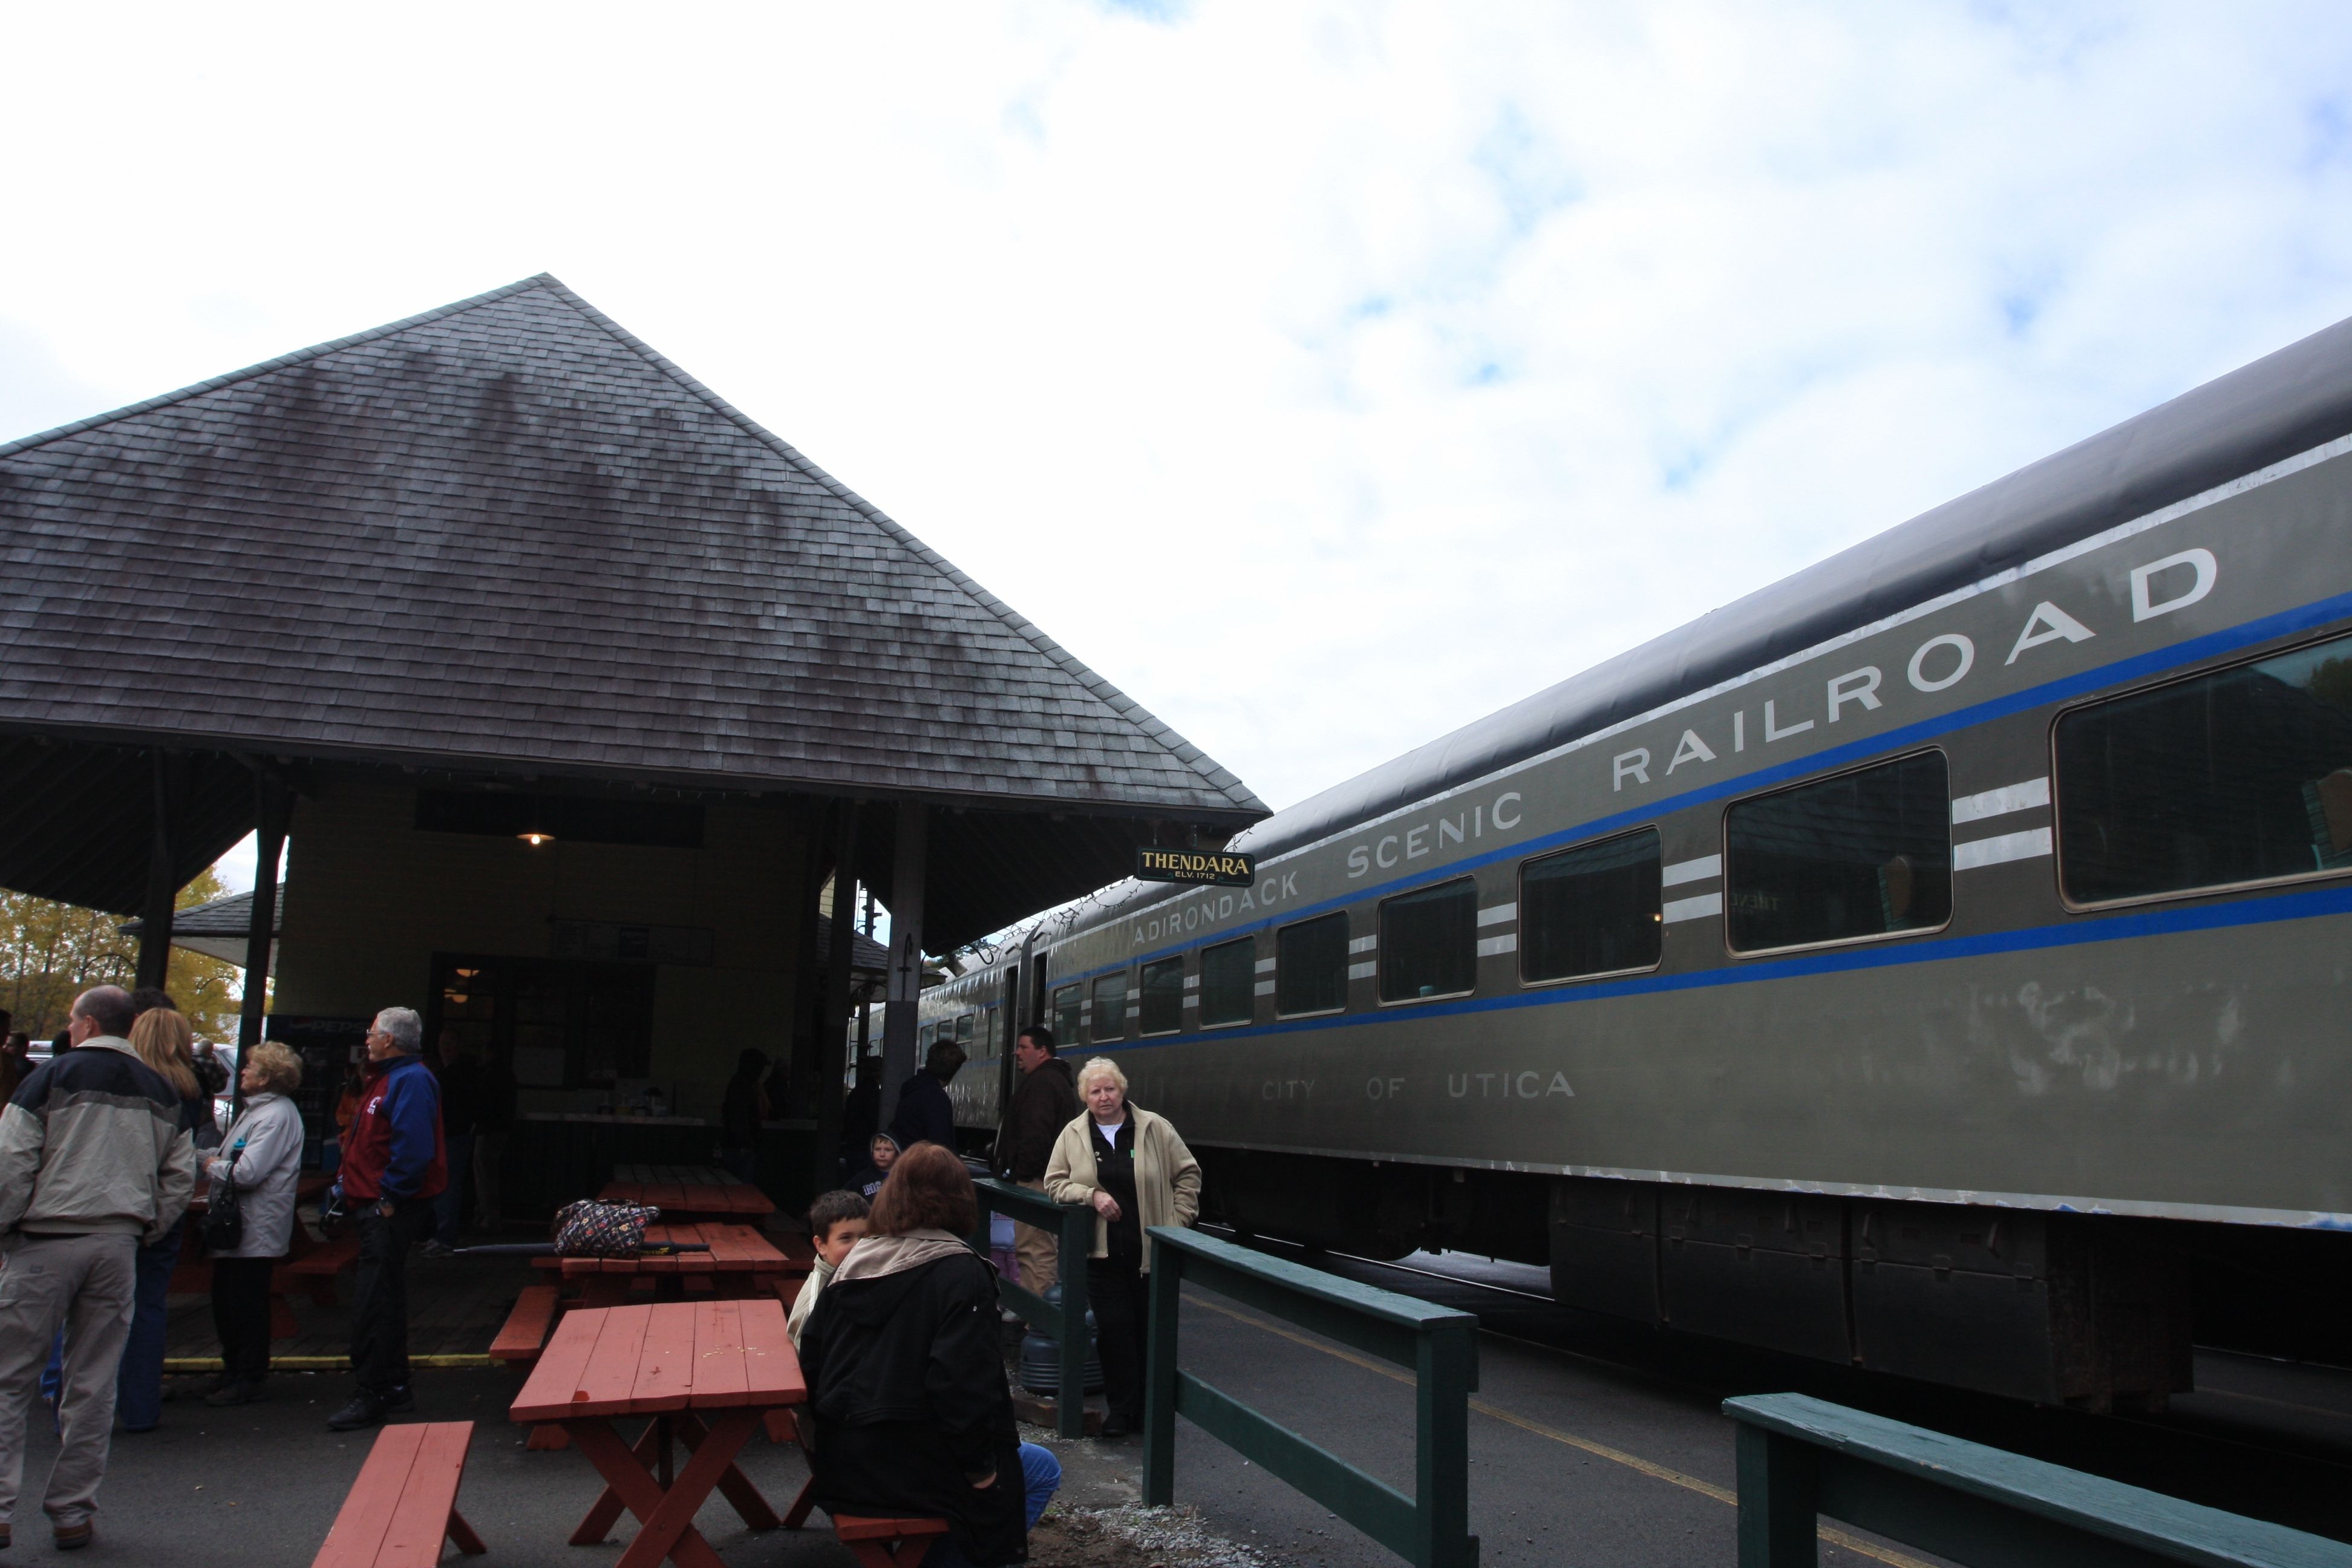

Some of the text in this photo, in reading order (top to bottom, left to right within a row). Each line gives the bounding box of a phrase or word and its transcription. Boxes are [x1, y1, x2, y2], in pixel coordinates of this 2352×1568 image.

[1132, 547, 2218, 947] ADIRONDACK SCENIC RAILROAD
[1141, 852, 1250, 875] THENDARA
[310, 1019, 367, 1034] PEPS
[1261, 1071, 1576, 1100] CITY OF UTICA
